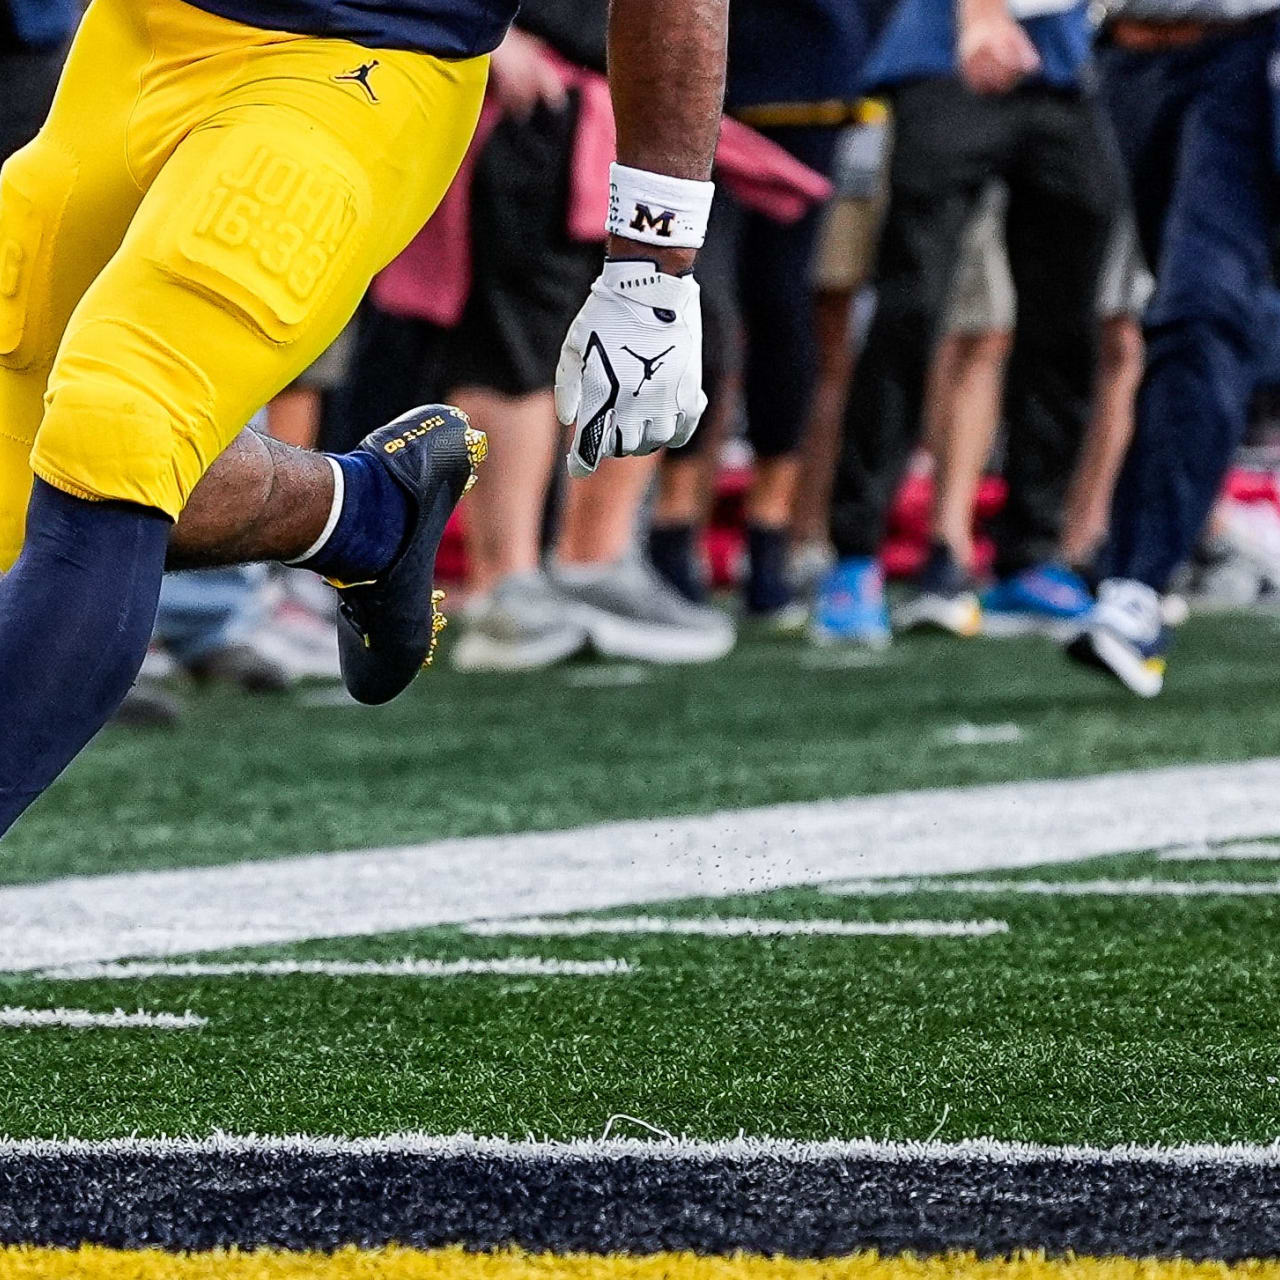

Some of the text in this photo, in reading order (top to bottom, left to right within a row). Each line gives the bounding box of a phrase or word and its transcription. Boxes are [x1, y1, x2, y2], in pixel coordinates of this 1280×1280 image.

[194, 184, 328, 300] 16:33
[219, 144, 360, 255] JOHN
[628, 202, 676, 238] M
